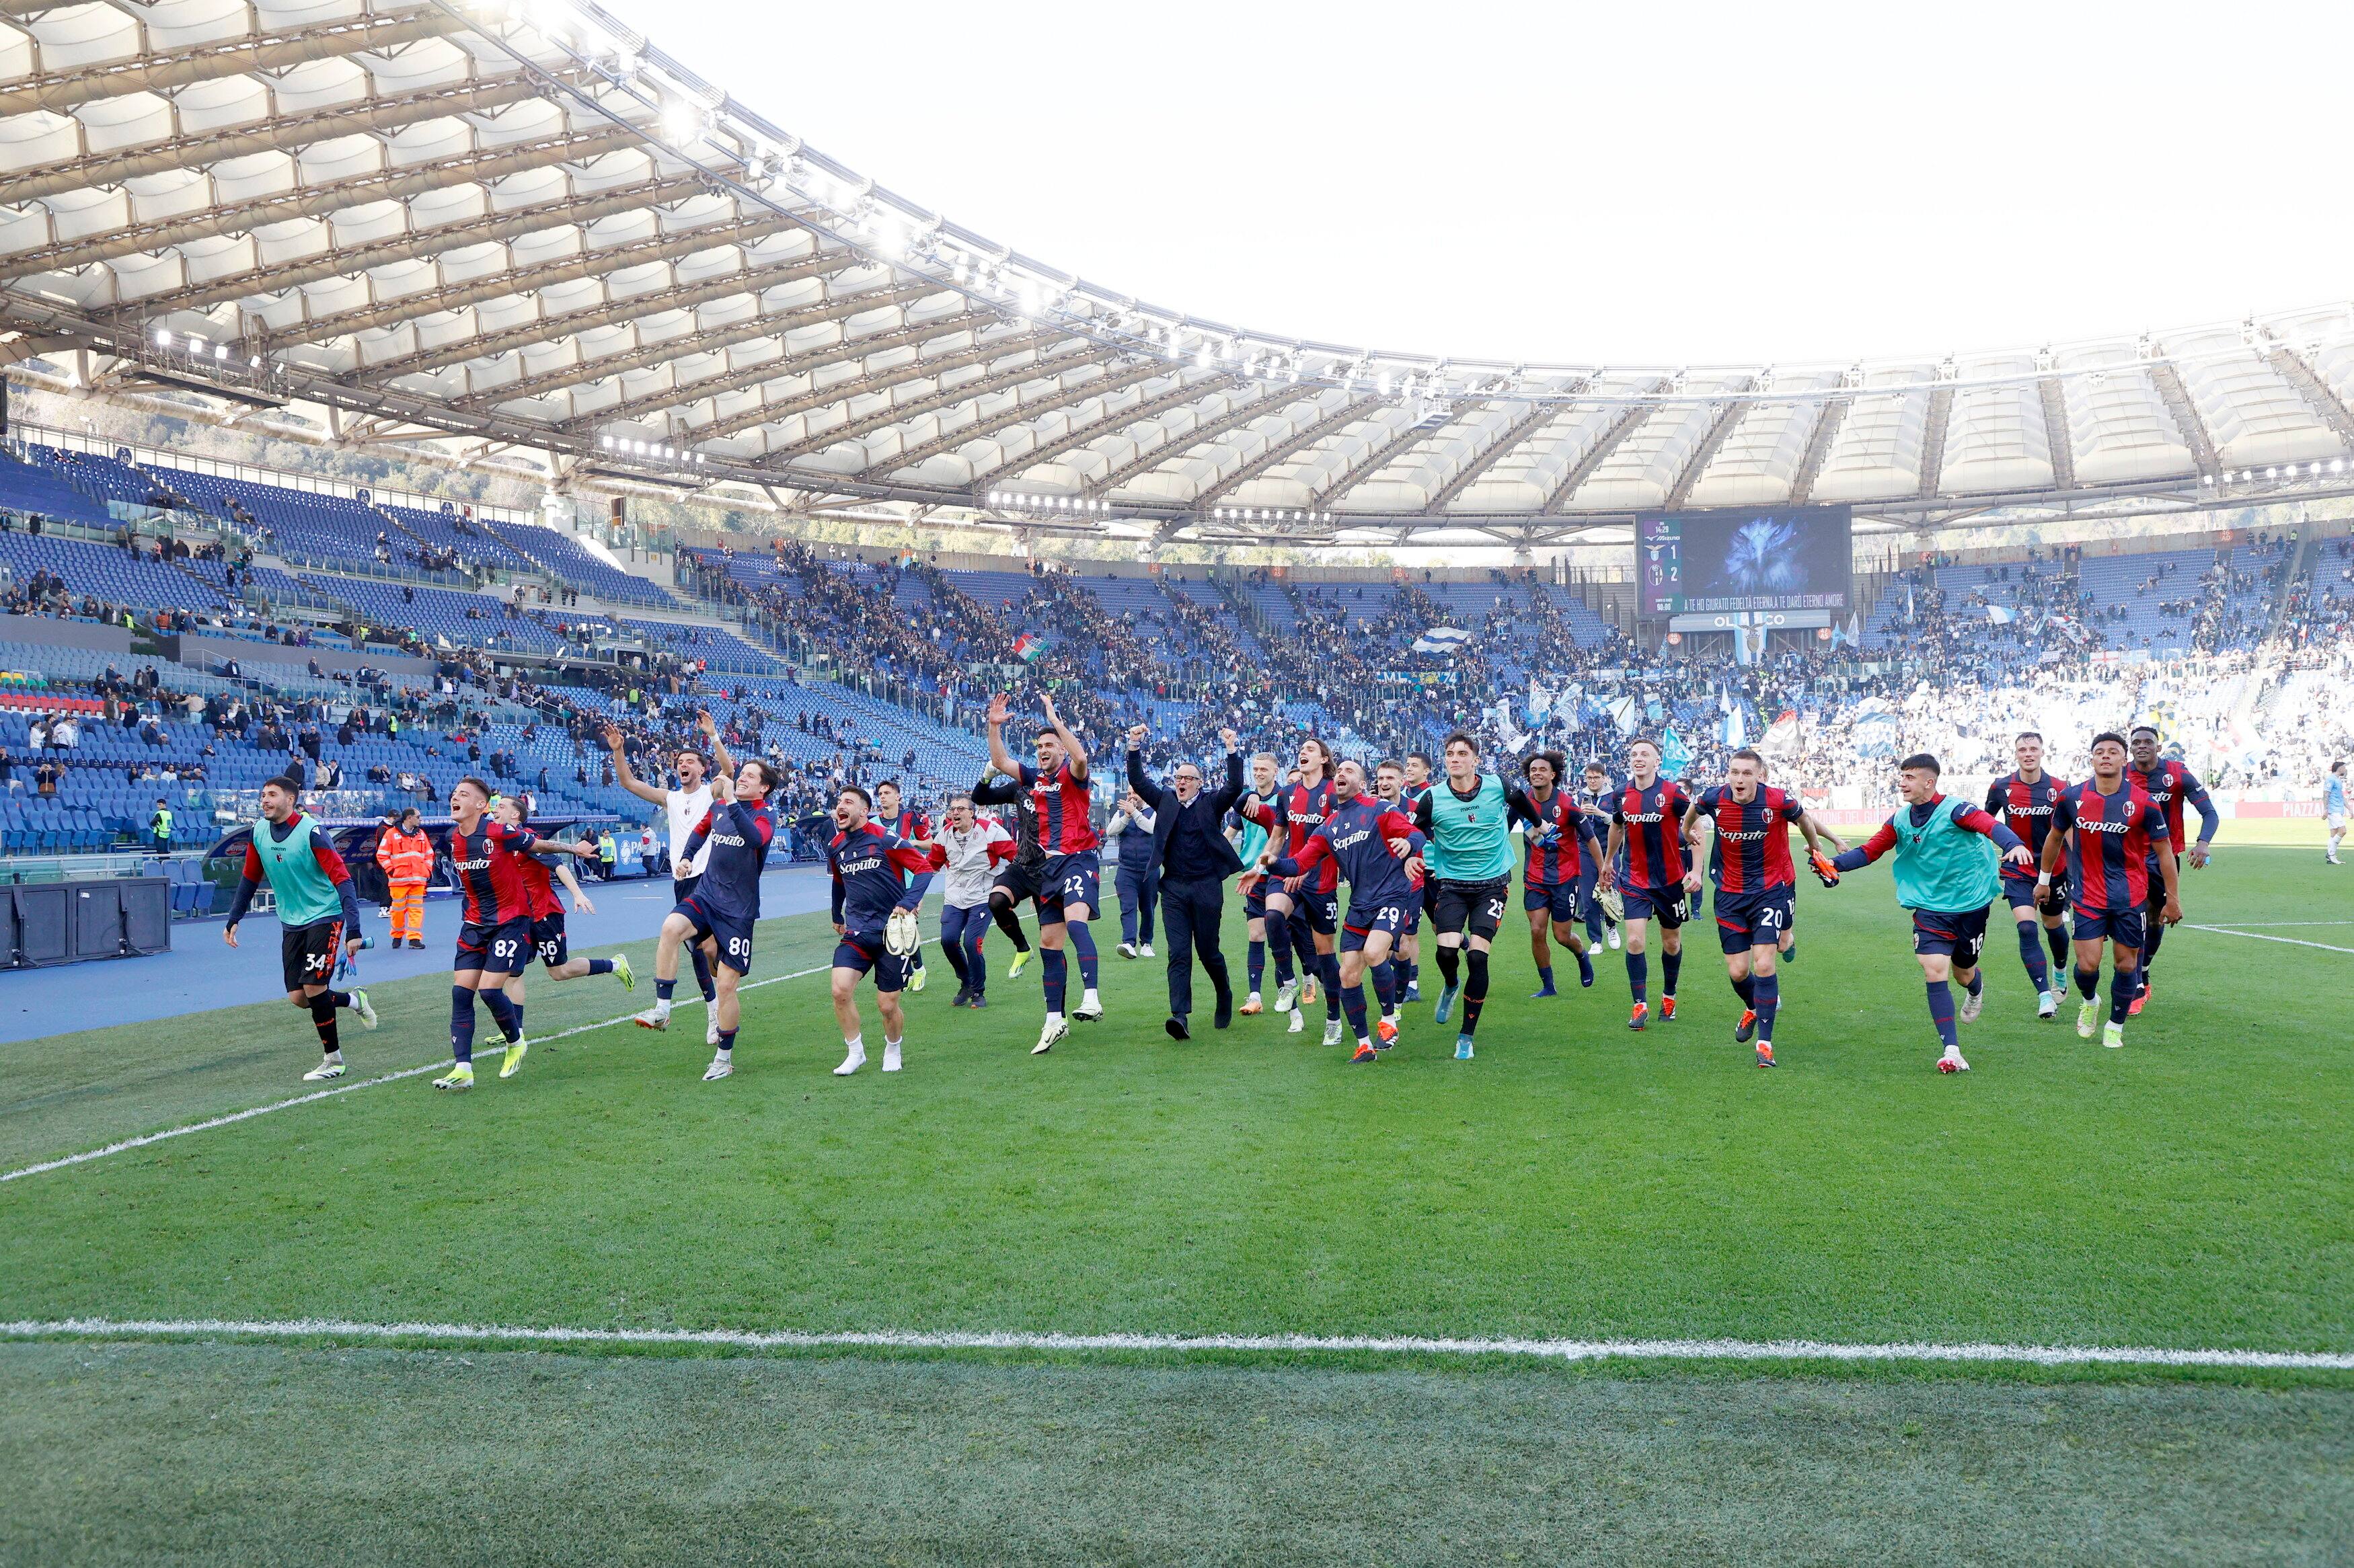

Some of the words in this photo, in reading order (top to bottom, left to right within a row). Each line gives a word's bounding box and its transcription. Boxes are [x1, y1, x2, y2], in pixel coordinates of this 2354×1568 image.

[1671, 545, 1676, 559] 1
[1671, 567, 1677, 582] 2
[1684, 599, 1687, 611] A
[1689, 598, 1695, 611] TE
[1697, 598, 1704, 611] HO
[1706, 598, 1729, 611] GIURATO
[1730, 595, 1752, 610] FEDELTÀ
[1780, 596, 1786, 608] TE
[1803, 594, 1823, 608] ETERNO
[1825, 594, 1844, 606] AMORE
[1034, 781, 1063, 794] Saputo
[1287, 810, 1325, 825] Saputo
[1622, 811, 1665, 826] Saputo
[2006, 803, 2054, 818] Saputo
[2075, 817, 2131, 834] Saputo
[1333, 829, 1371, 851] Saputo
[1717, 826, 1770, 843] Saputo
[839, 857, 882, 875] Saputo
[1064, 875, 1084, 894] 22
[1487, 898, 1504, 919] 23
[1568, 893, 1575, 908] 9
[1672, 898, 1685, 918] 19
[1325, 902, 1337, 920] 33
[1377, 906, 1399, 923] 29
[1761, 907, 1783, 929] 20
[494, 939, 518, 957] 82
[539, 941, 558, 956] 56
[728, 937, 750, 957] 80
[1969, 933, 1983, 955] 16
[305, 953, 326, 971] 34
[901, 955, 909, 973] 7
